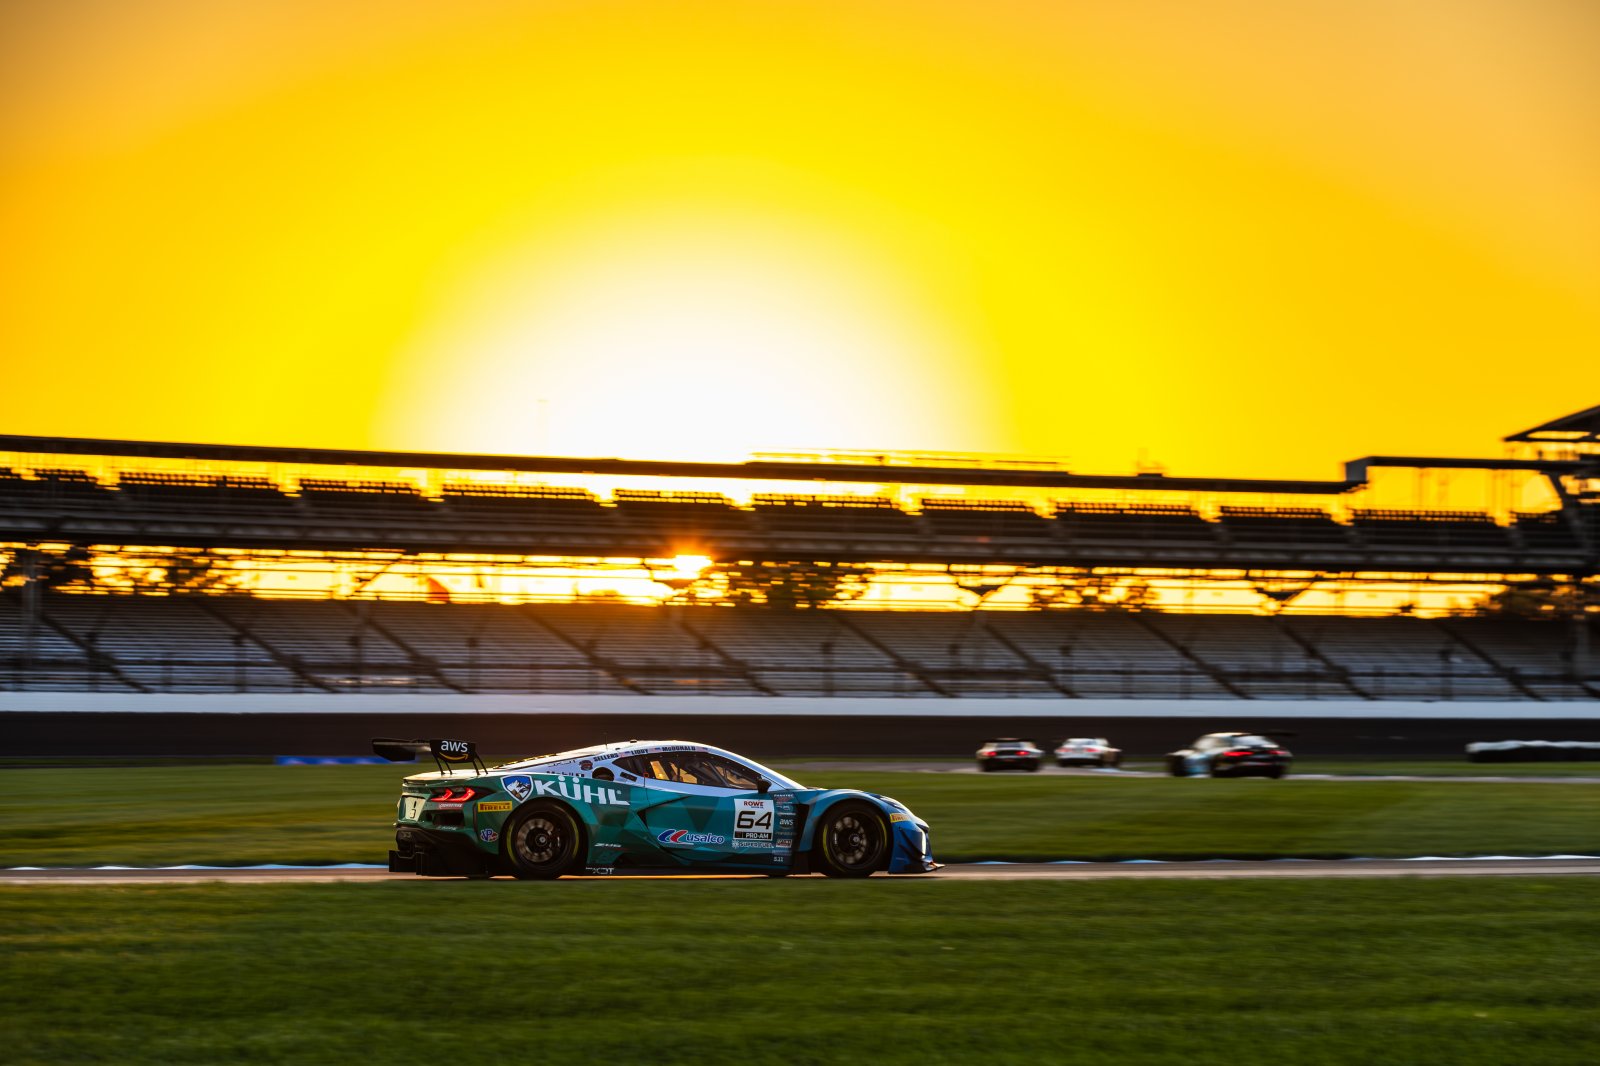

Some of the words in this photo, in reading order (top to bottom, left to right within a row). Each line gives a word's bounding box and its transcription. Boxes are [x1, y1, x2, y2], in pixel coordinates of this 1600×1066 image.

[441, 740, 467, 752] aws
[593, 752, 619, 762] SELLERS
[534, 775, 631, 806] KÜHL
[480, 802, 511, 811] PIRELLI
[737, 810, 772, 829] 64
[779, 818, 794, 826] aws
[686, 833, 724, 844] usalco
[745, 832, 769, 840] PRO-AM
